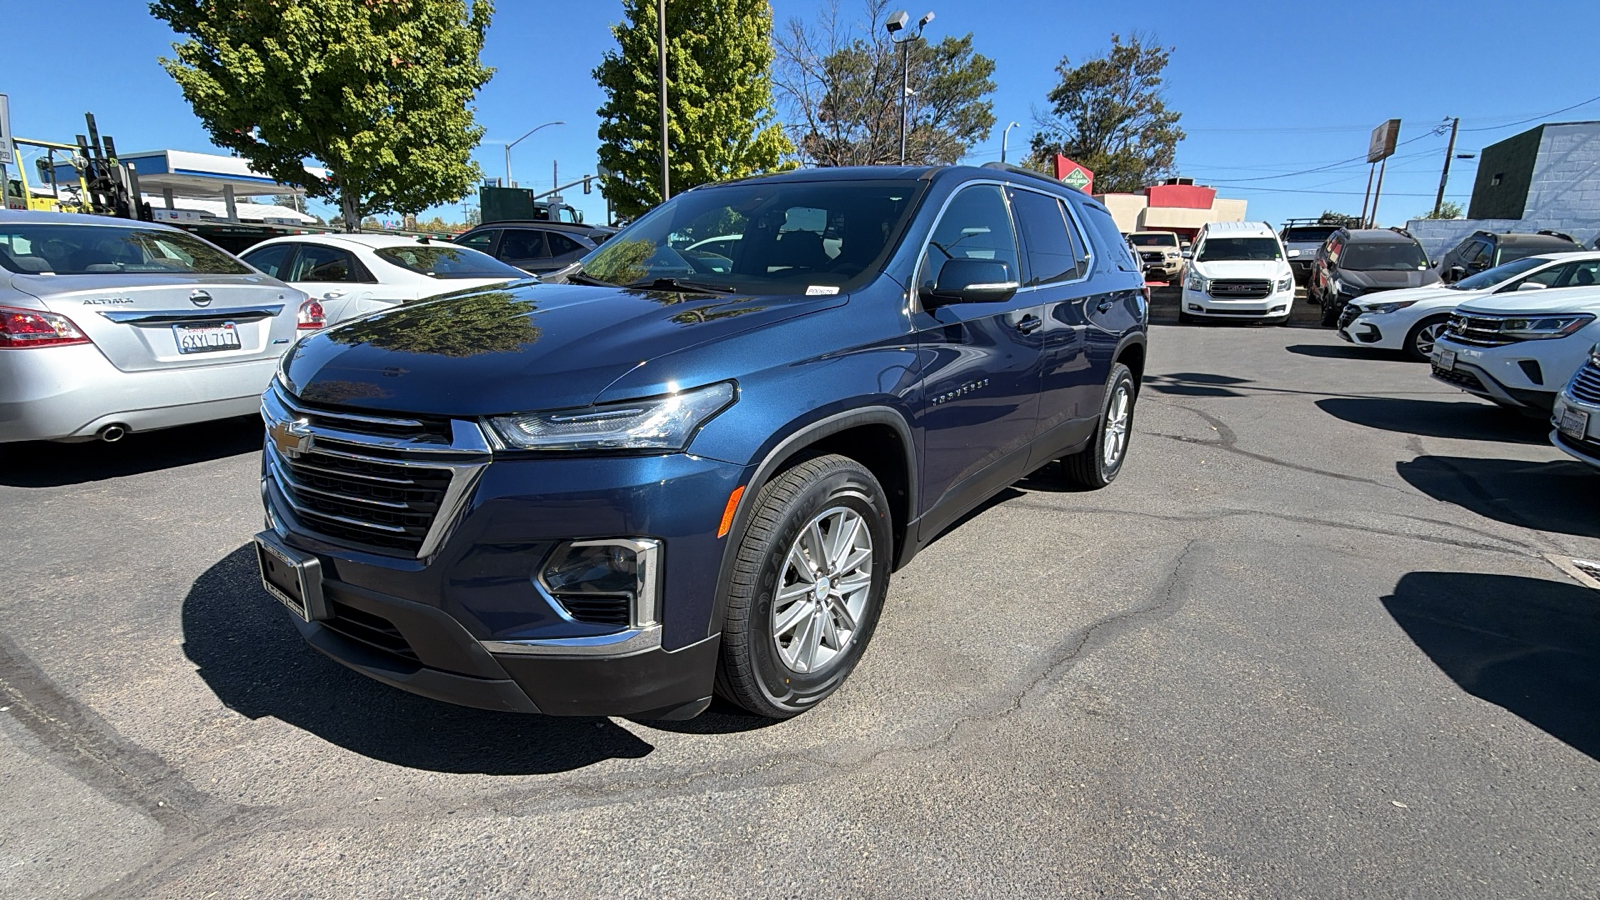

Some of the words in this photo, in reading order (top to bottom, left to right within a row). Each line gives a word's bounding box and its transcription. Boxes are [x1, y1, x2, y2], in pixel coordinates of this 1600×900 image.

[1227, 284, 1251, 292] GMC
[83, 297, 134, 305] ALTIMA
[932, 378, 989, 406] TRAVERSE
[764, 496, 815, 589] SAILUN
